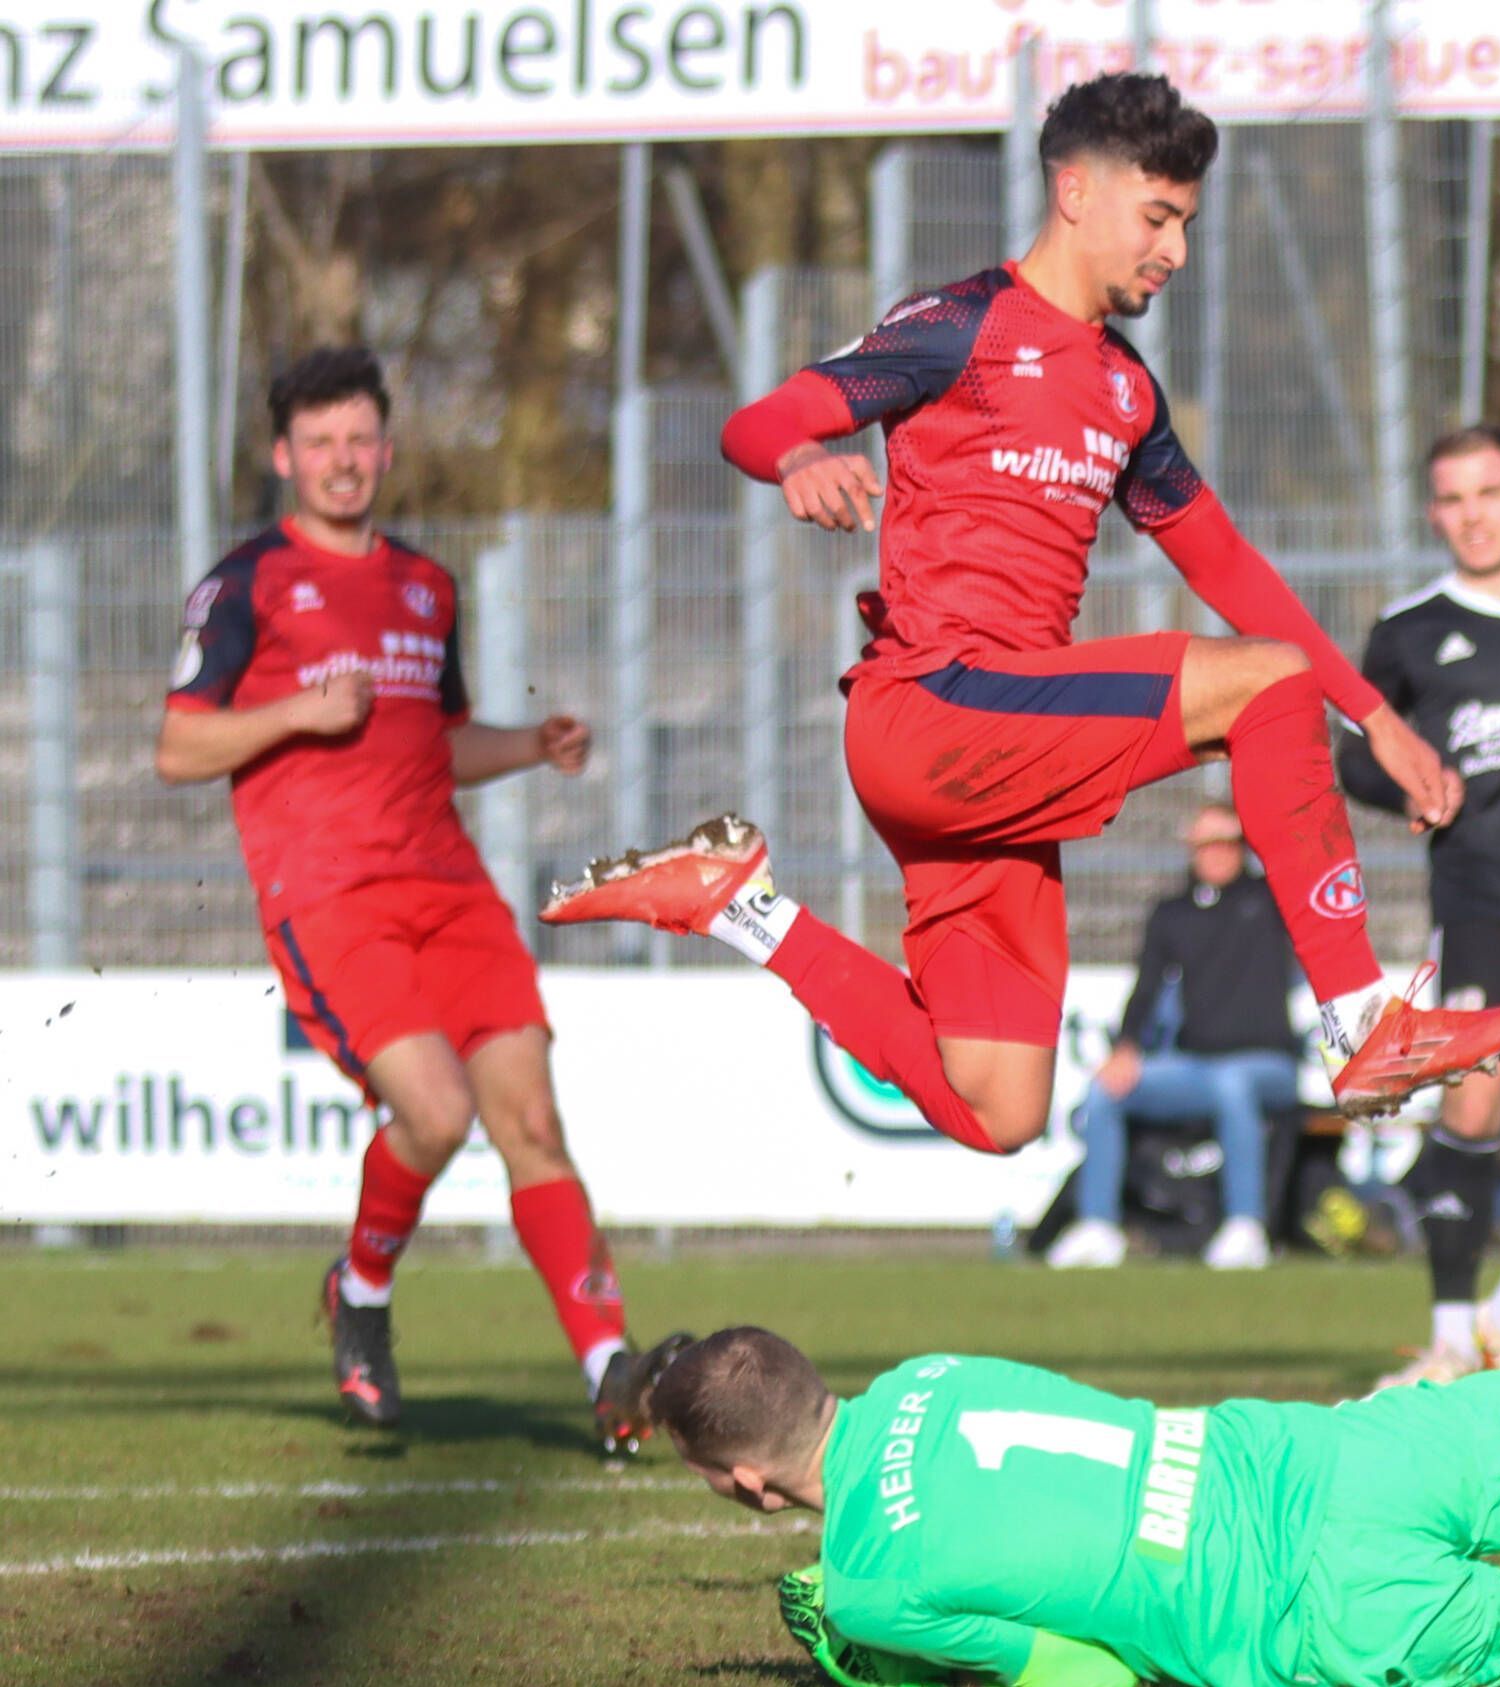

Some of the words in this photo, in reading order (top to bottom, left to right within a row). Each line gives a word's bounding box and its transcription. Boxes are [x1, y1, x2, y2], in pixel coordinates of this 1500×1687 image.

[147, 0, 805, 107] Samuelsen
[880, 1390, 934, 1532] HEIDER
[957, 1409, 1136, 1470] 1
